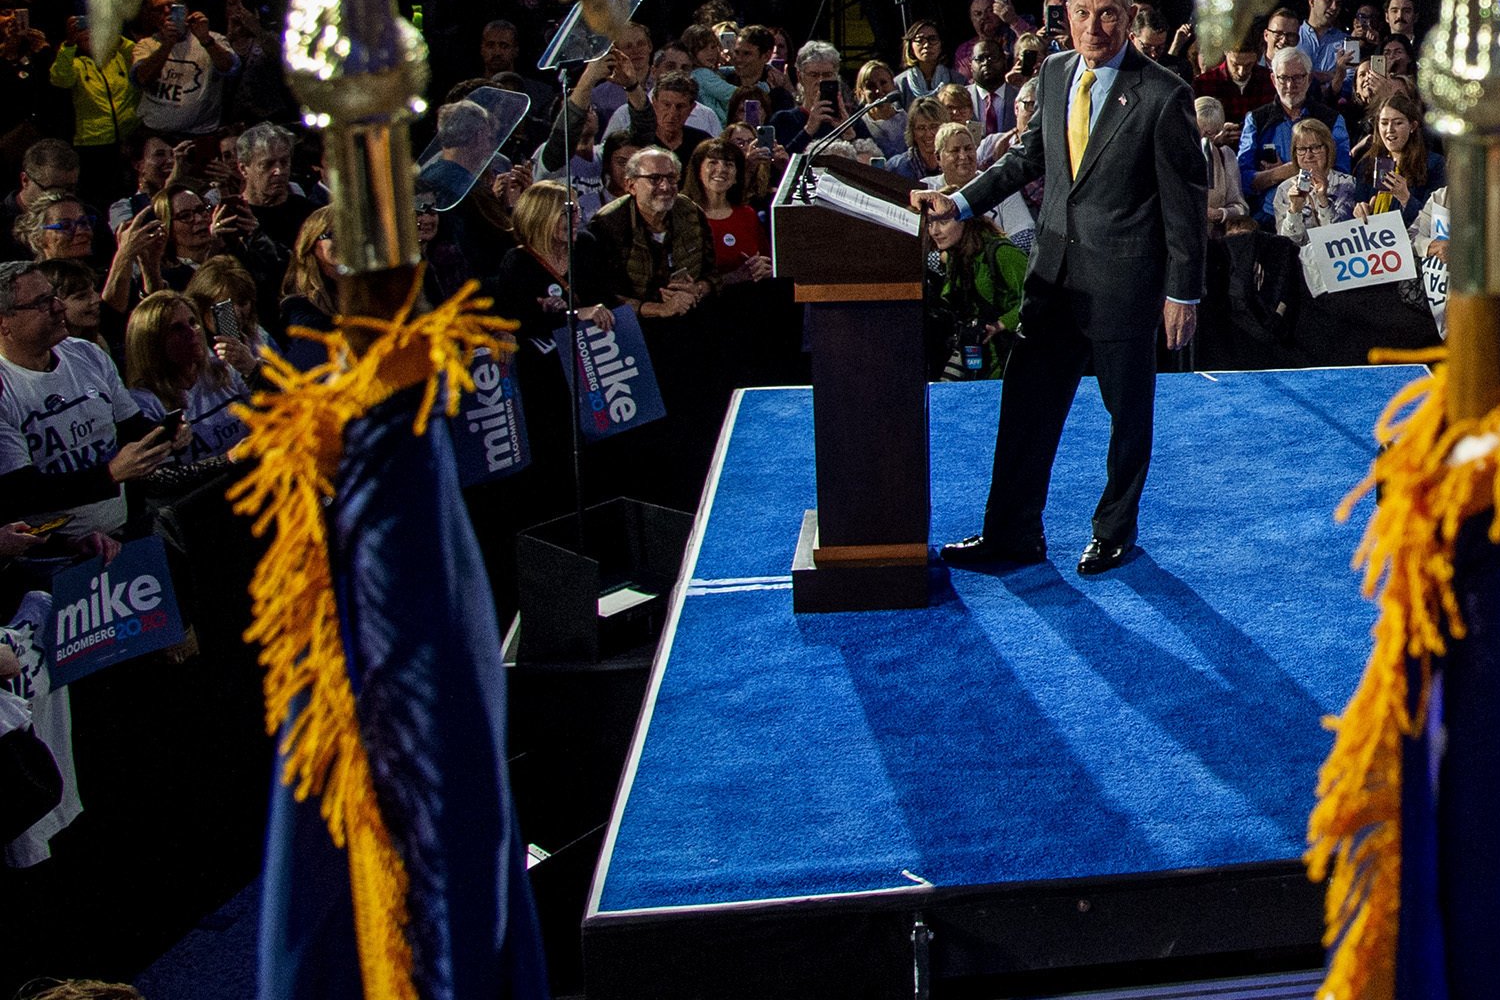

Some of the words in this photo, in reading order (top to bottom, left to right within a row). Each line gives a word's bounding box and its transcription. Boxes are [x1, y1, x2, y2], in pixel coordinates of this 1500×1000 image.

[1325, 225, 1397, 259] mike
[1333, 250, 1402, 282] 2020
[575, 330, 600, 392] BLOOMBERG
[585, 325, 640, 424] mike
[466, 362, 513, 473] mike
[505, 398, 521, 464] BLOOMBERG
[588, 390, 610, 432] 2020
[26, 425, 67, 462] PA
[69, 418, 95, 444] for
[56, 571, 162, 646] mike
[56, 625, 116, 663] BLOOMBERG
[115, 610, 168, 641] 2020
